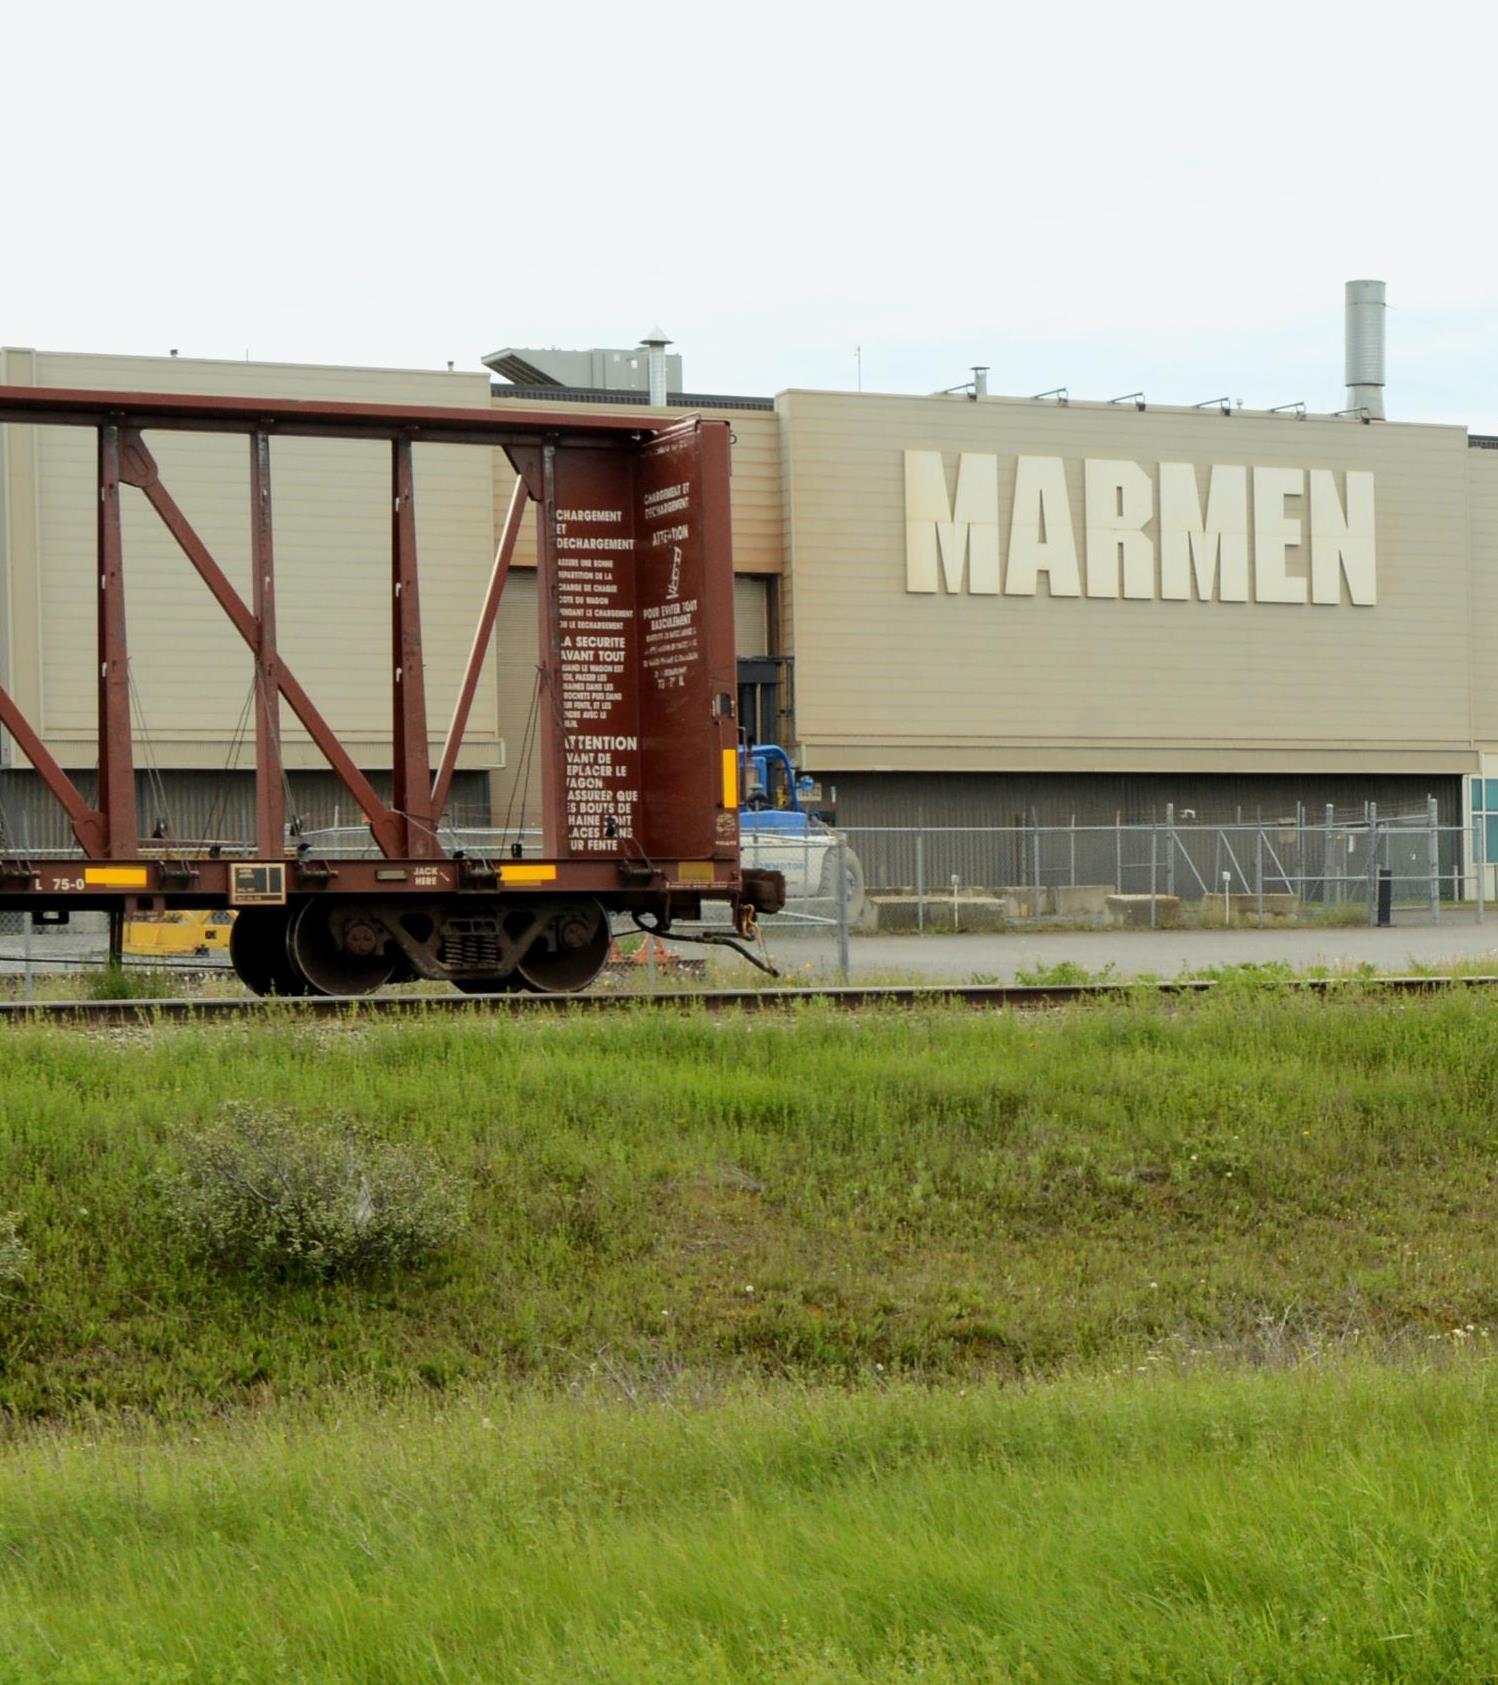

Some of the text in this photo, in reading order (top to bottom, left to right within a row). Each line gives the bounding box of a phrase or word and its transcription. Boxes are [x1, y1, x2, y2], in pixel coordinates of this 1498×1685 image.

[556, 509, 622, 522] CHARGEMENT
[556, 523, 567, 535] ET
[904, 449, 1377, 606] MARMEN
[556, 537, 634, 550] DECHARGEMENT
[604, 572, 612, 580] LA
[576, 636, 625, 648] SECURITE
[561, 650, 626, 662] AVANT TOUT
[566, 753, 612, 764] VANT DE
[566, 765, 627, 777] EPLACER LE
[566, 777, 603, 789] AGON
[616, 791, 638, 802] QUE
[580, 802, 615, 813] BOUTS
[618, 803, 631, 814] DE
[568, 815, 600, 826] HAINE
[568, 827, 600, 838] ACES
[588, 839, 618, 851] FENTE
[413, 867, 438, 876] JACK
[415, 876, 437, 885] HERE
